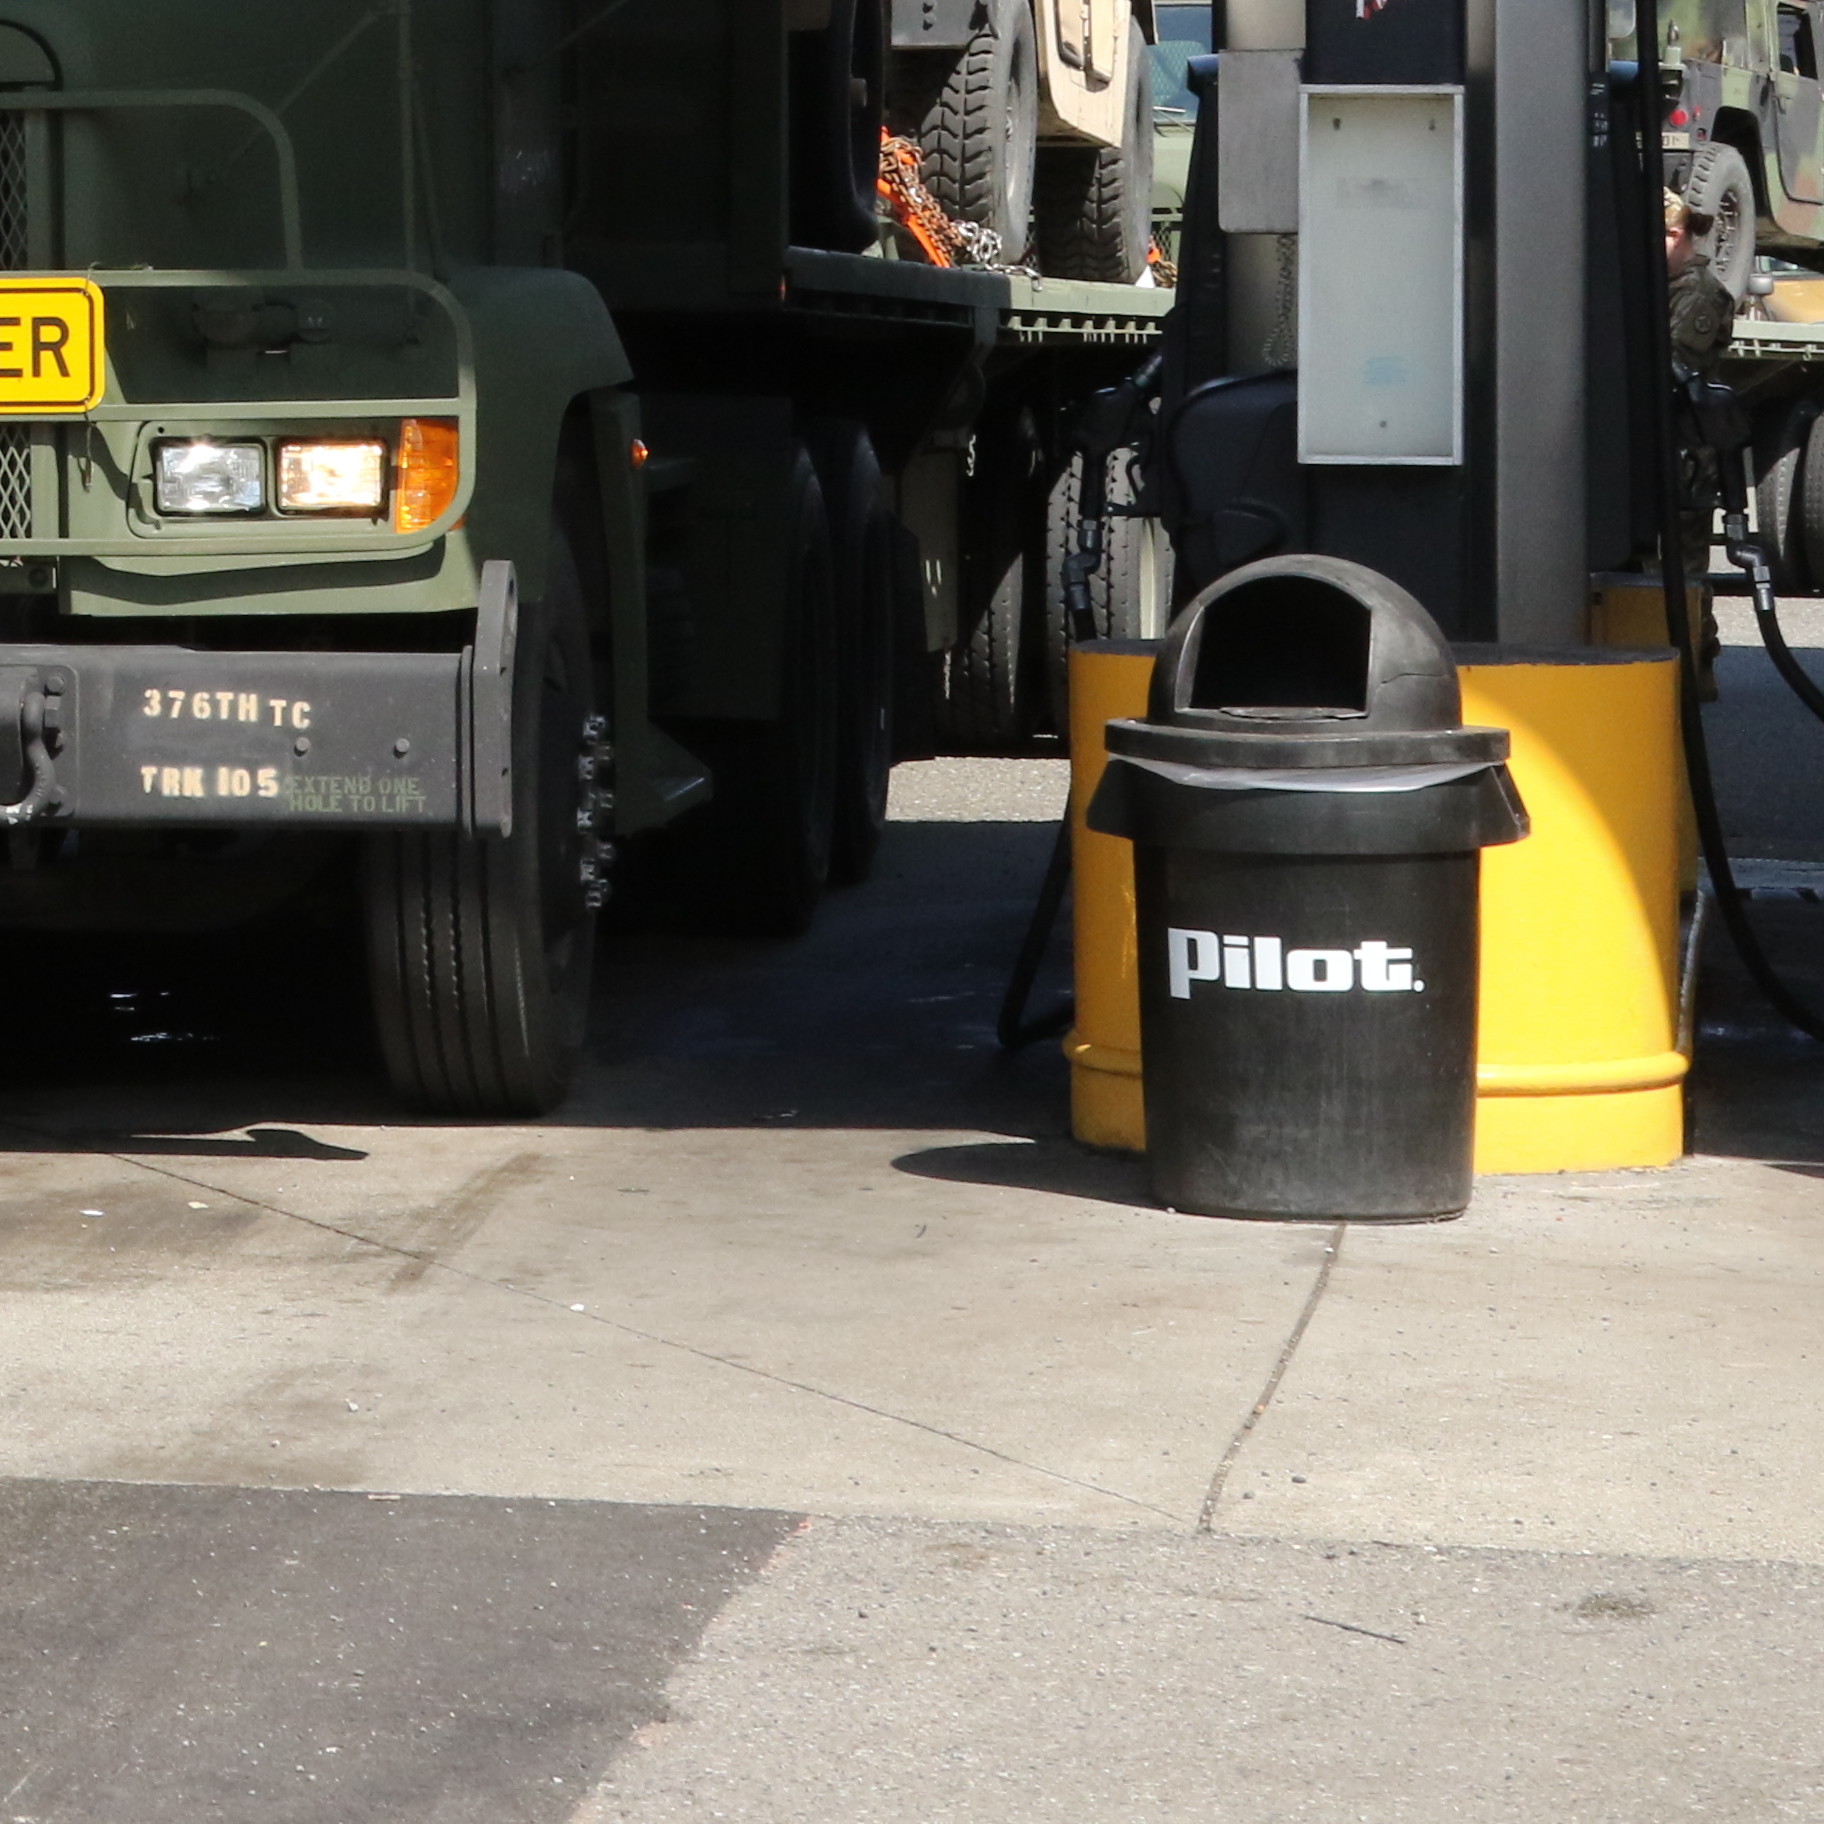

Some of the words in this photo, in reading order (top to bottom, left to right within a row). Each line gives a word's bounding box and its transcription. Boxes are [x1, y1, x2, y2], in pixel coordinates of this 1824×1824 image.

[143, 688, 259, 723] 376TH
[269, 698, 312, 729] TC
[141, 766, 204, 798] TRK
[217, 767, 279, 798] 105
[288, 777, 372, 796] EXTEND
[378, 777, 421, 796] ONE
[289, 794, 342, 813] HOLE
[350, 795, 376, 813] TO
[382, 796, 427, 814] LIFT
